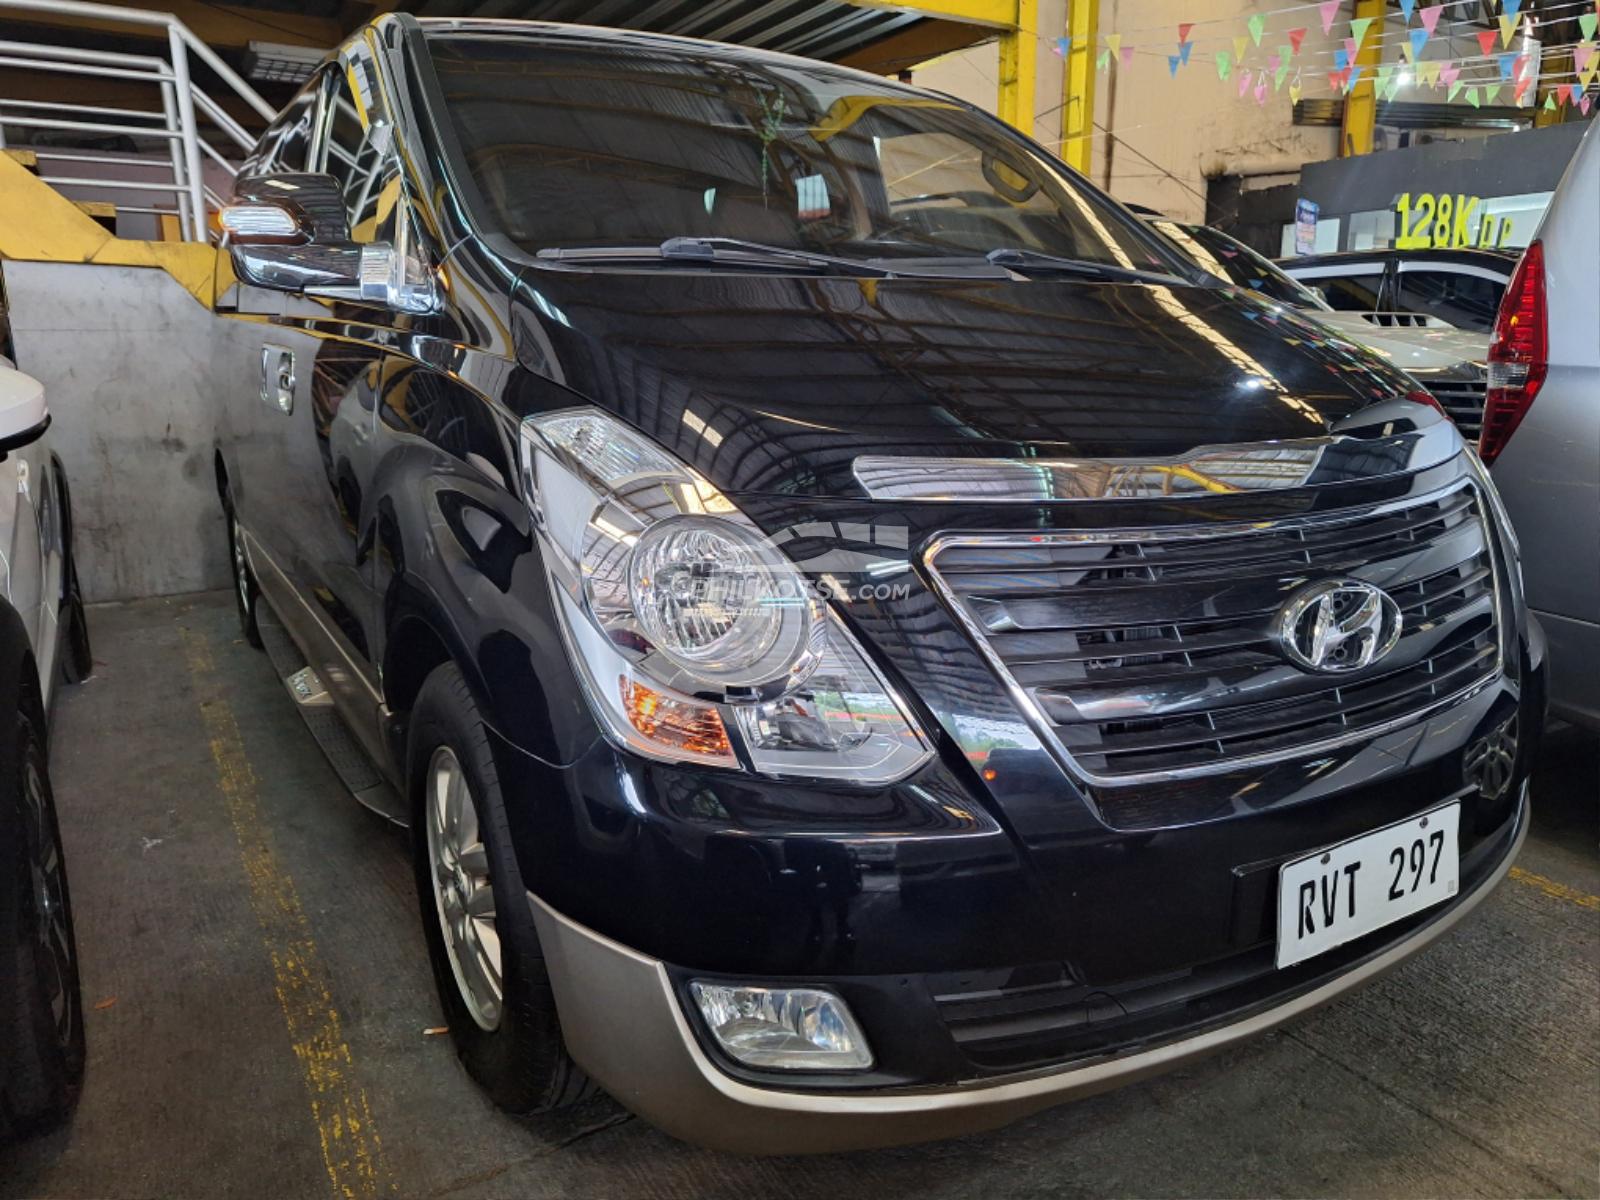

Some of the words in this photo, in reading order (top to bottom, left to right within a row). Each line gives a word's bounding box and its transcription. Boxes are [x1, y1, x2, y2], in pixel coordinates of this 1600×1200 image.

[1395, 192, 1480, 249] 128K
[1298, 861, 1361, 940] RVT
[1388, 829, 1444, 901] 297
